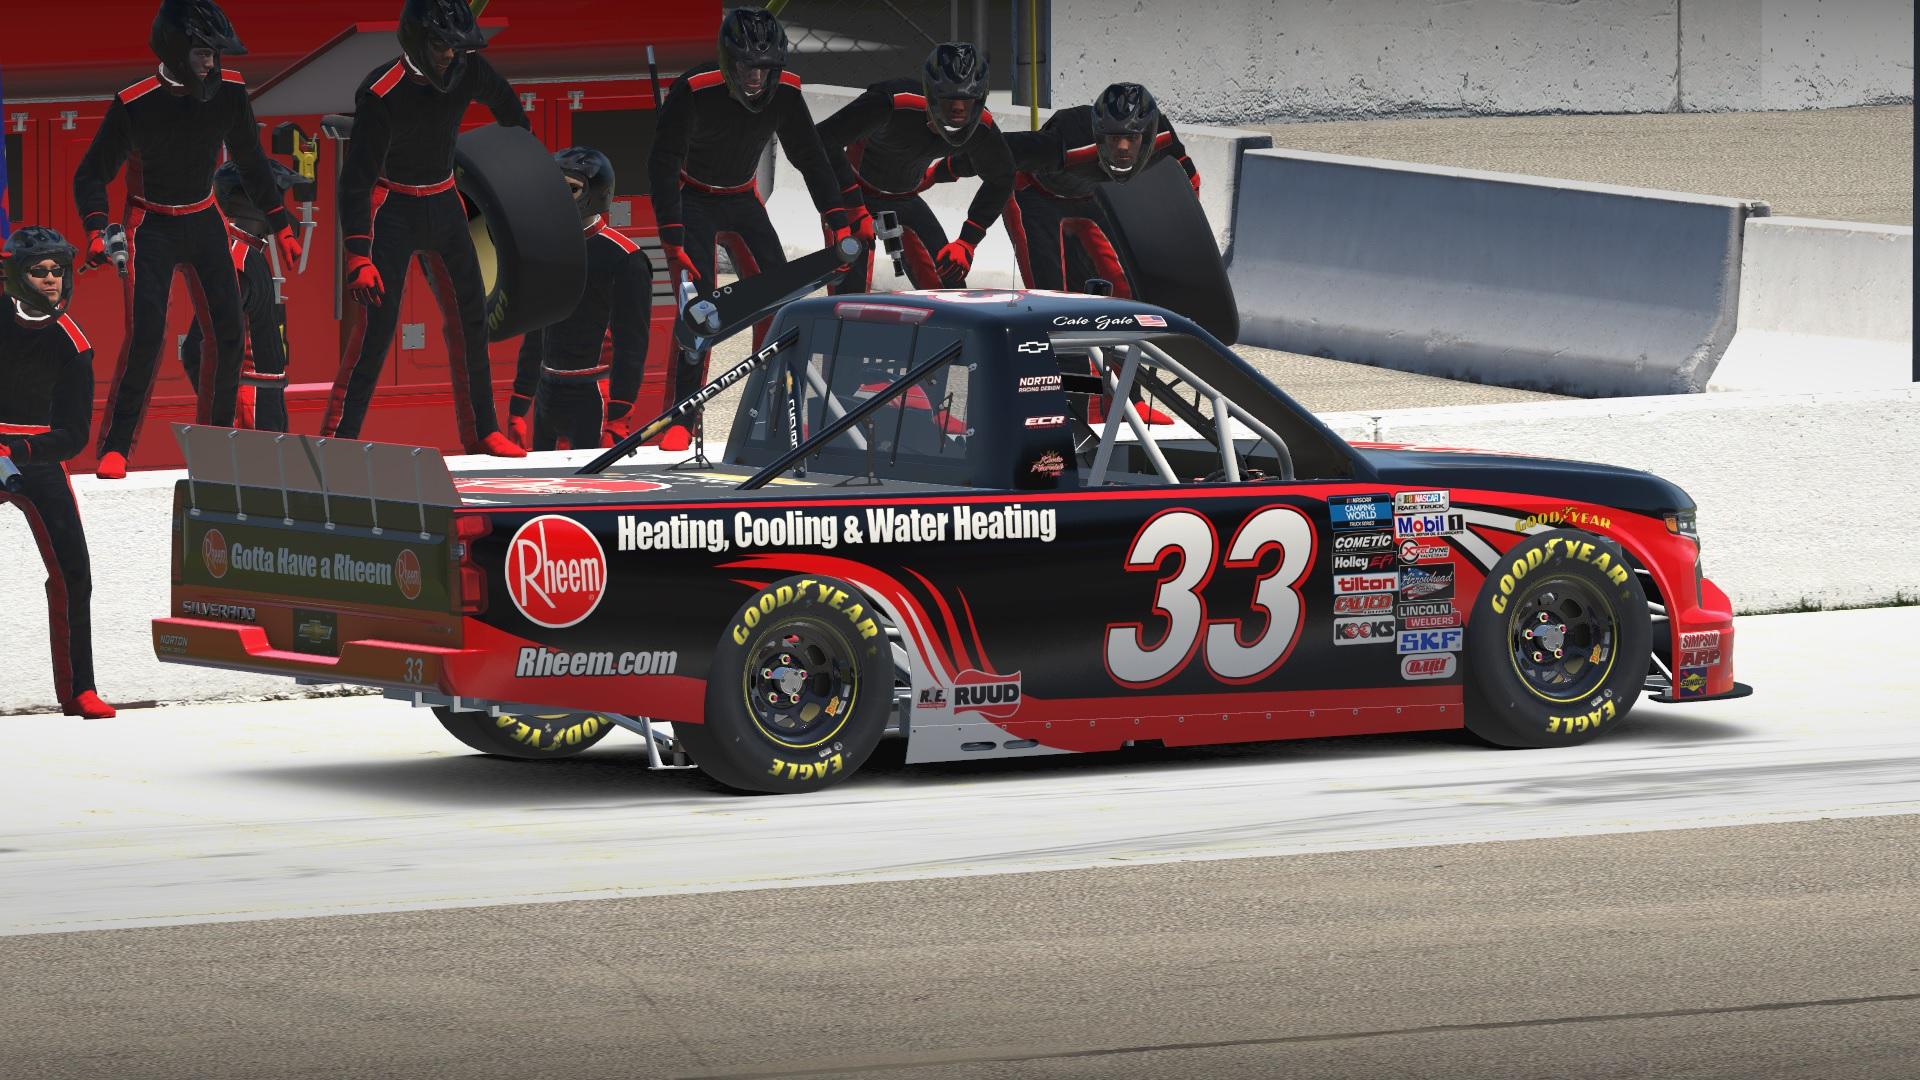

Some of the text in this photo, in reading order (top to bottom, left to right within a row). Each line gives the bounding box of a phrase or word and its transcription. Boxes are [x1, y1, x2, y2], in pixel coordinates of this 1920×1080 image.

[1053, 315, 1134, 330] Cale Gale
[679, 341, 780, 415] CHEVROLET
[1019, 375, 1062, 387] NORTON
[1025, 416, 1065, 426] ECR
[1414, 493, 1441, 503] NASCAR
[1344, 504, 1376, 512] CAMPING
[1346, 511, 1377, 520] WORLD
[617, 504, 1057, 552] Heating, Cooling & Water Heating
[1398, 515, 1444, 533] Mobil
[1335, 533, 1392, 549] COMETIC
[231, 542, 392, 586] Gotta Have a Rheem
[517, 520, 600, 608] Rheem
[1335, 555, 1369, 570] Holley
[1338, 576, 1396, 592] tilton
[1402, 570, 1453, 585] Arrowhead
[1104, 504, 1318, 689] 33
[1335, 594, 1392, 611] CALICO
[182, 600, 257, 622] SILVERADO
[1400, 603, 1449, 616] LINCOLN
[1411, 617, 1454, 627] WELDERS
[1336, 621, 1395, 640] KOOKS
[160, 634, 188, 647] NORTON
[1400, 631, 1461, 651] SKF
[1682, 633, 1718, 648] SIMPSON
[515, 647, 678, 678] Rheem.com
[1680, 650, 1720, 666] ARP
[403, 657, 424, 684] 33
[1681, 679, 1706, 688] SUNOCO
[954, 683, 1020, 706] RUUD
[1546, 700, 1616, 735] EAGLE
[767, 752, 843, 781] EAGLE
